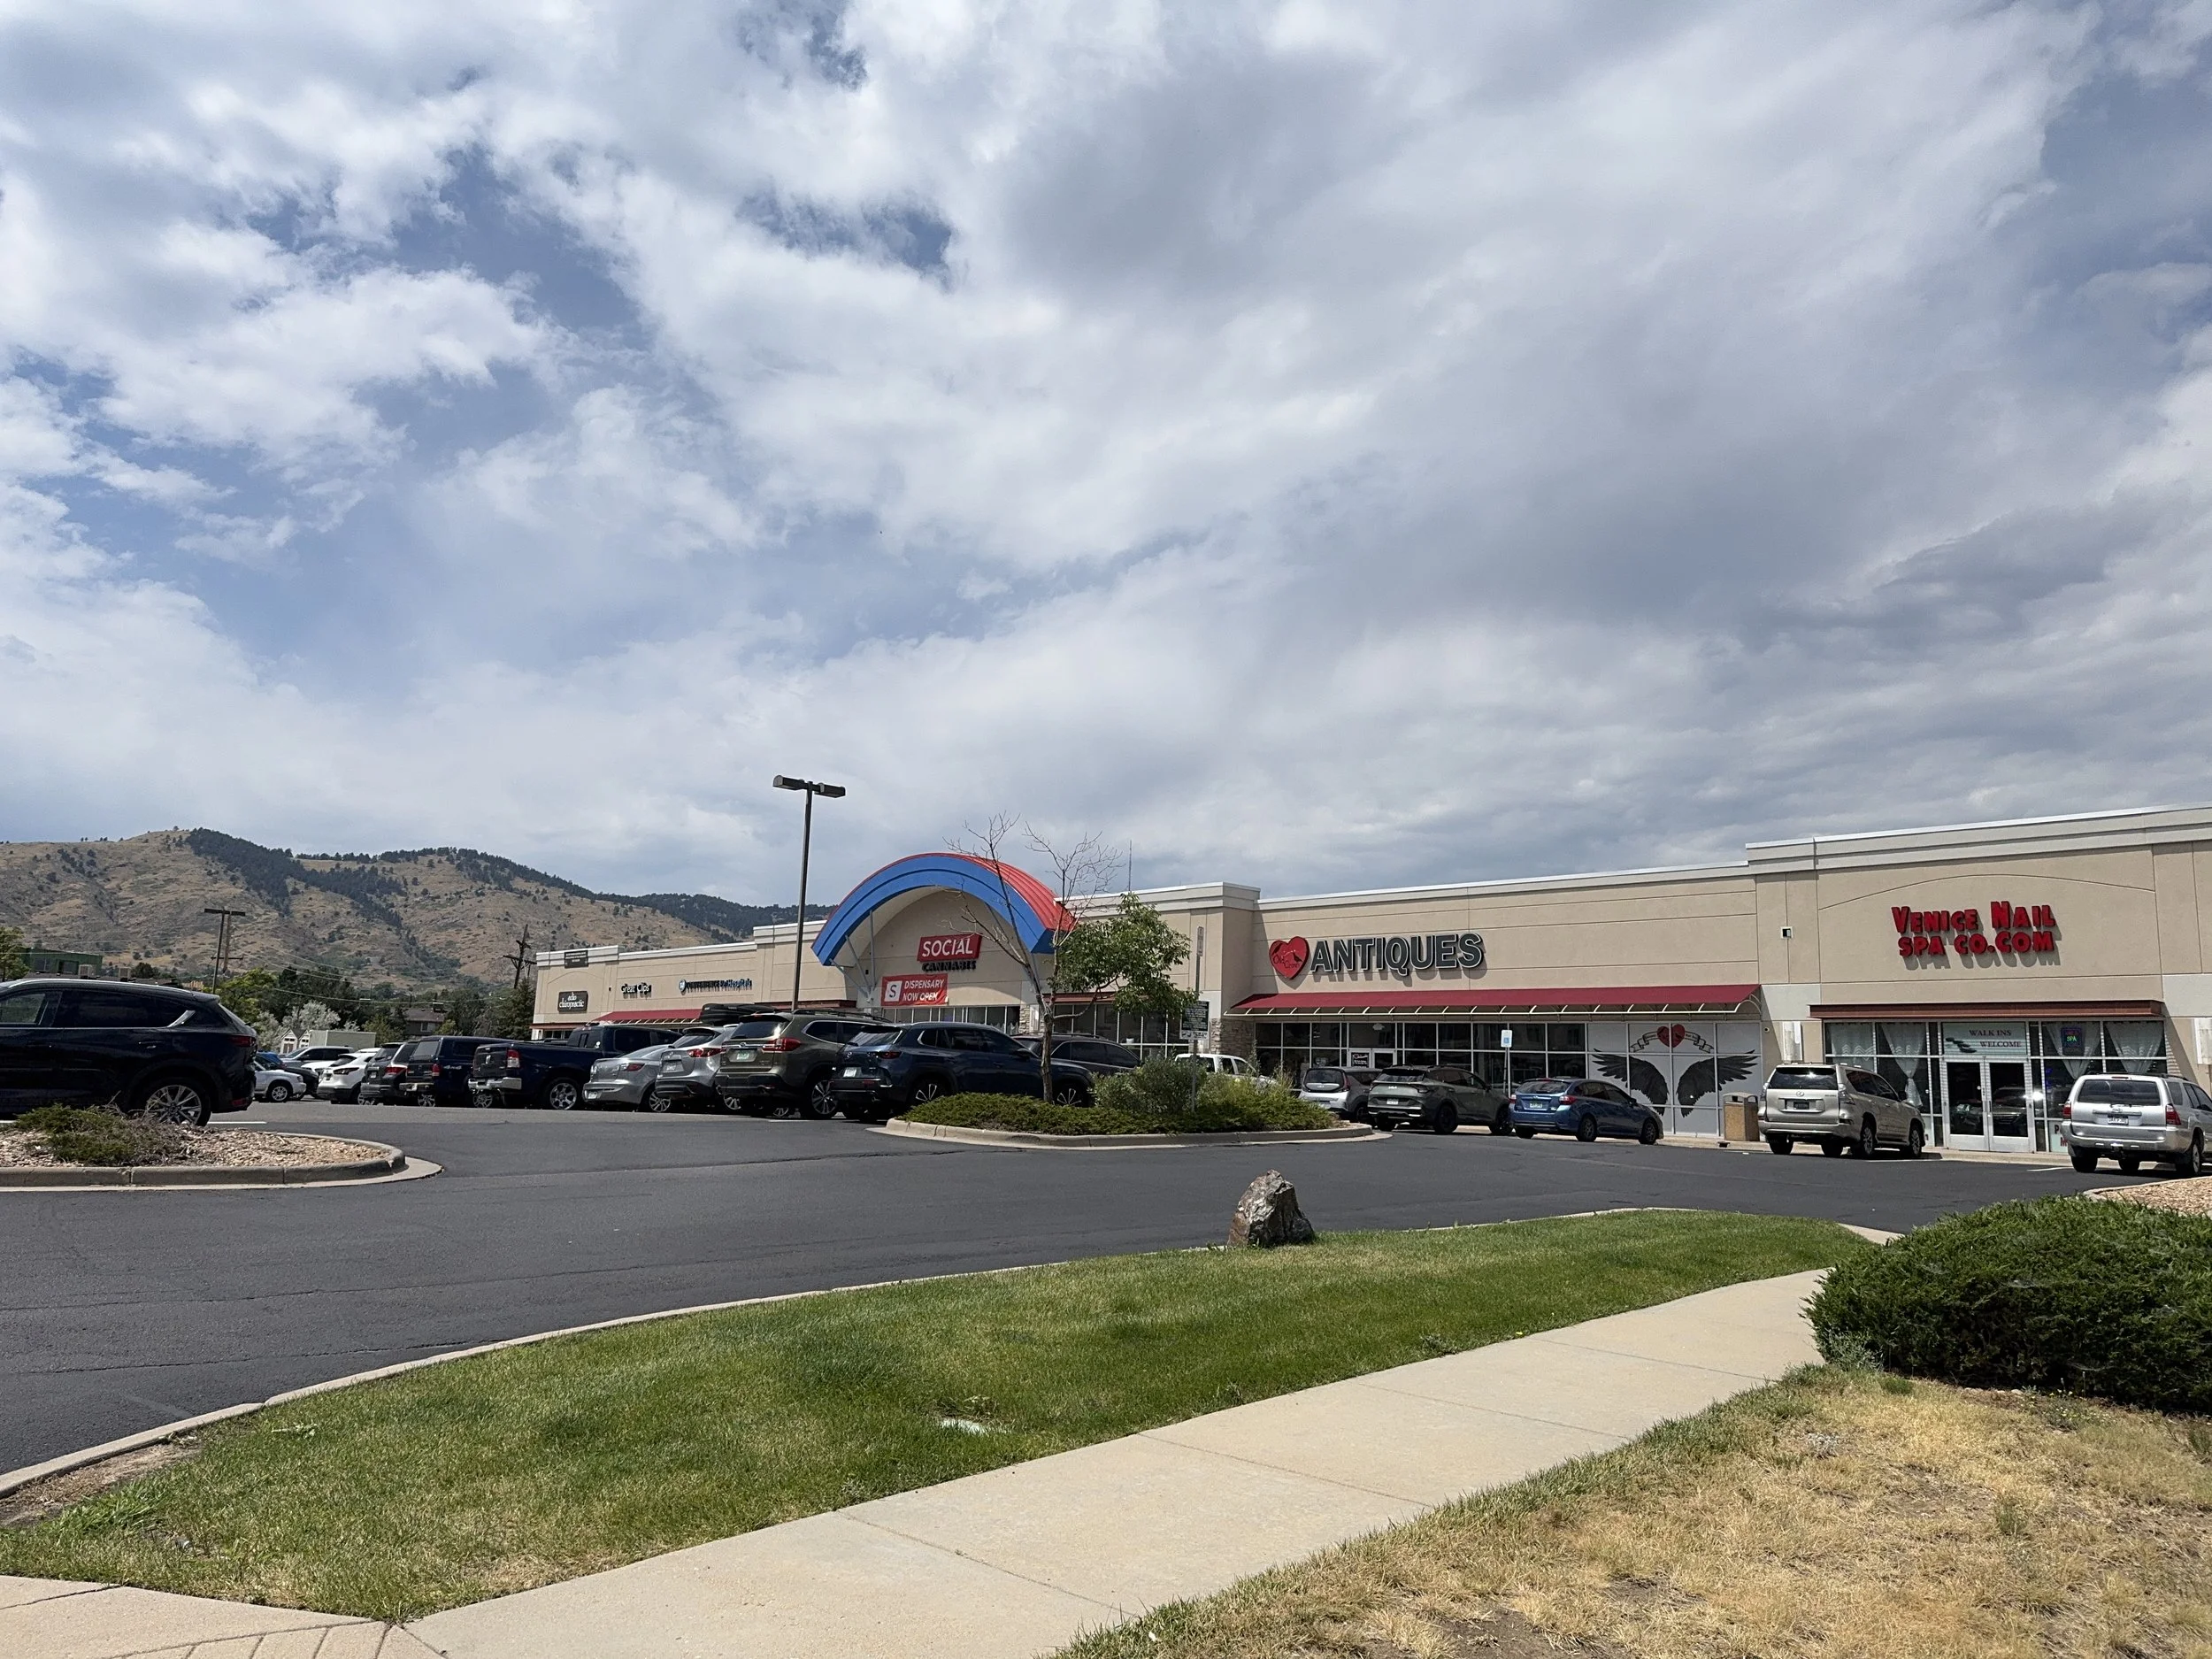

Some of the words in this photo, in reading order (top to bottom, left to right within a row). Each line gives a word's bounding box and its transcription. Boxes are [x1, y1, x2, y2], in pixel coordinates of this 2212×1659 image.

[1891, 906, 1979, 933] VENICE
[1990, 901, 2056, 929] NAIL
[921, 938, 974, 956] SOCIAL
[1898, 935, 1947, 957] SPA
[1954, 931, 2055, 955] CO.COM
[1310, 932, 1486, 977] ANTIQUES
[922, 960, 977, 972] CANNABIS
[621, 983, 637, 995] Great
[637, 982, 652, 995] Clips
[903, 979, 945, 990] DISPENSARY
[558, 997, 585, 1010] chiropractic
[902, 992, 919, 1002] NOW
[919, 992, 939, 1002] OPEN
